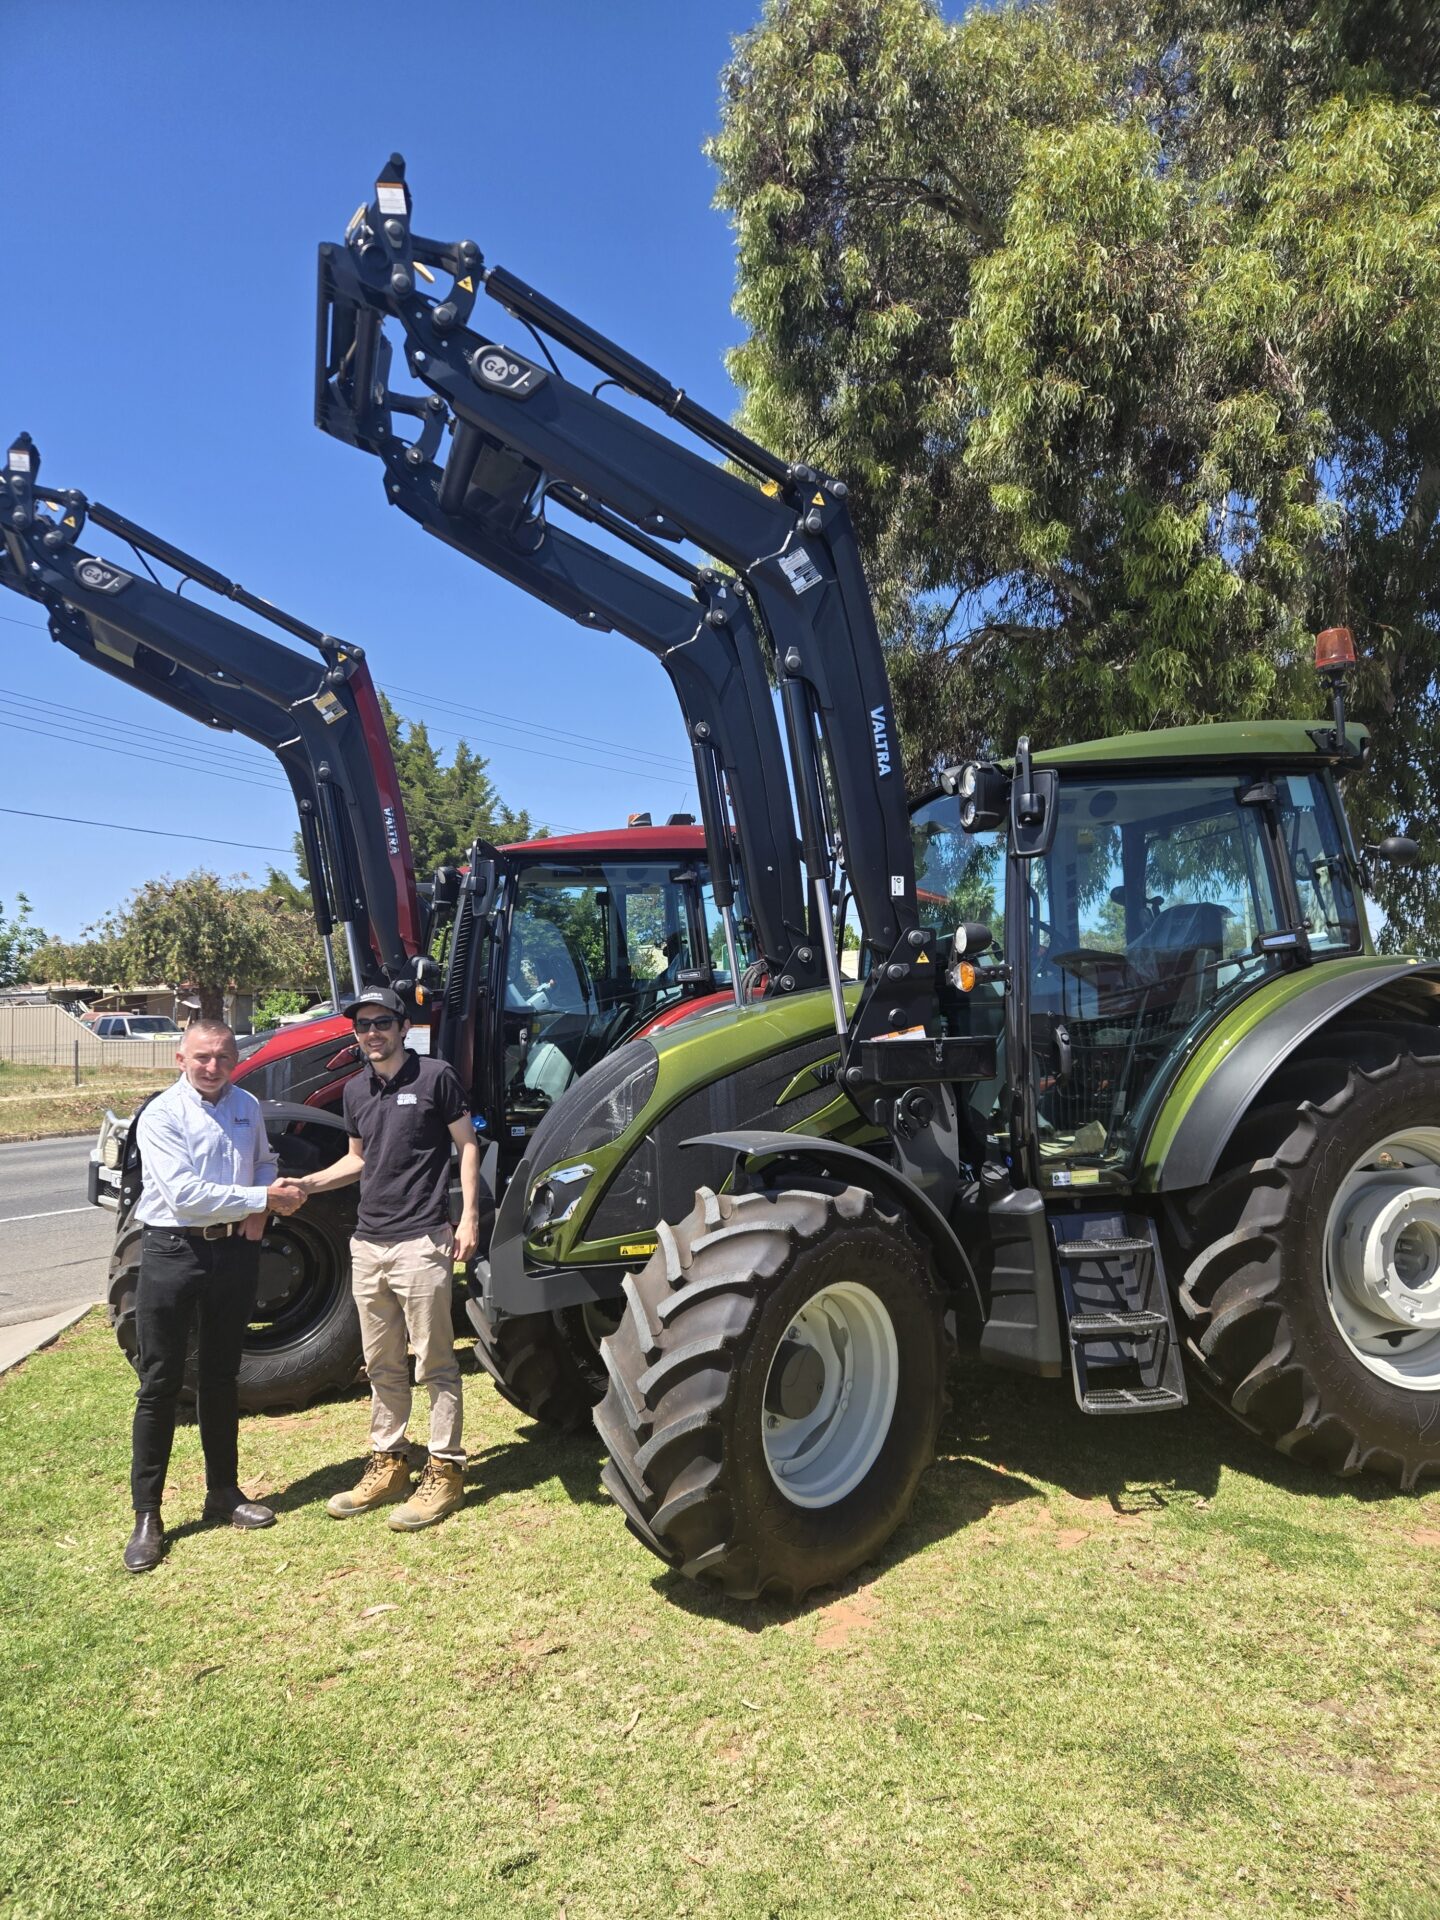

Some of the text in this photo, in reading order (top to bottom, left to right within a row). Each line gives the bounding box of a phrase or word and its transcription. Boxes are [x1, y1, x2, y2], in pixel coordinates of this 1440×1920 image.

[484, 359, 506, 377] G4
[84, 568, 100, 581] G4
[870, 705, 892, 777] VALTRA
[383, 806, 400, 856] VALTRA
